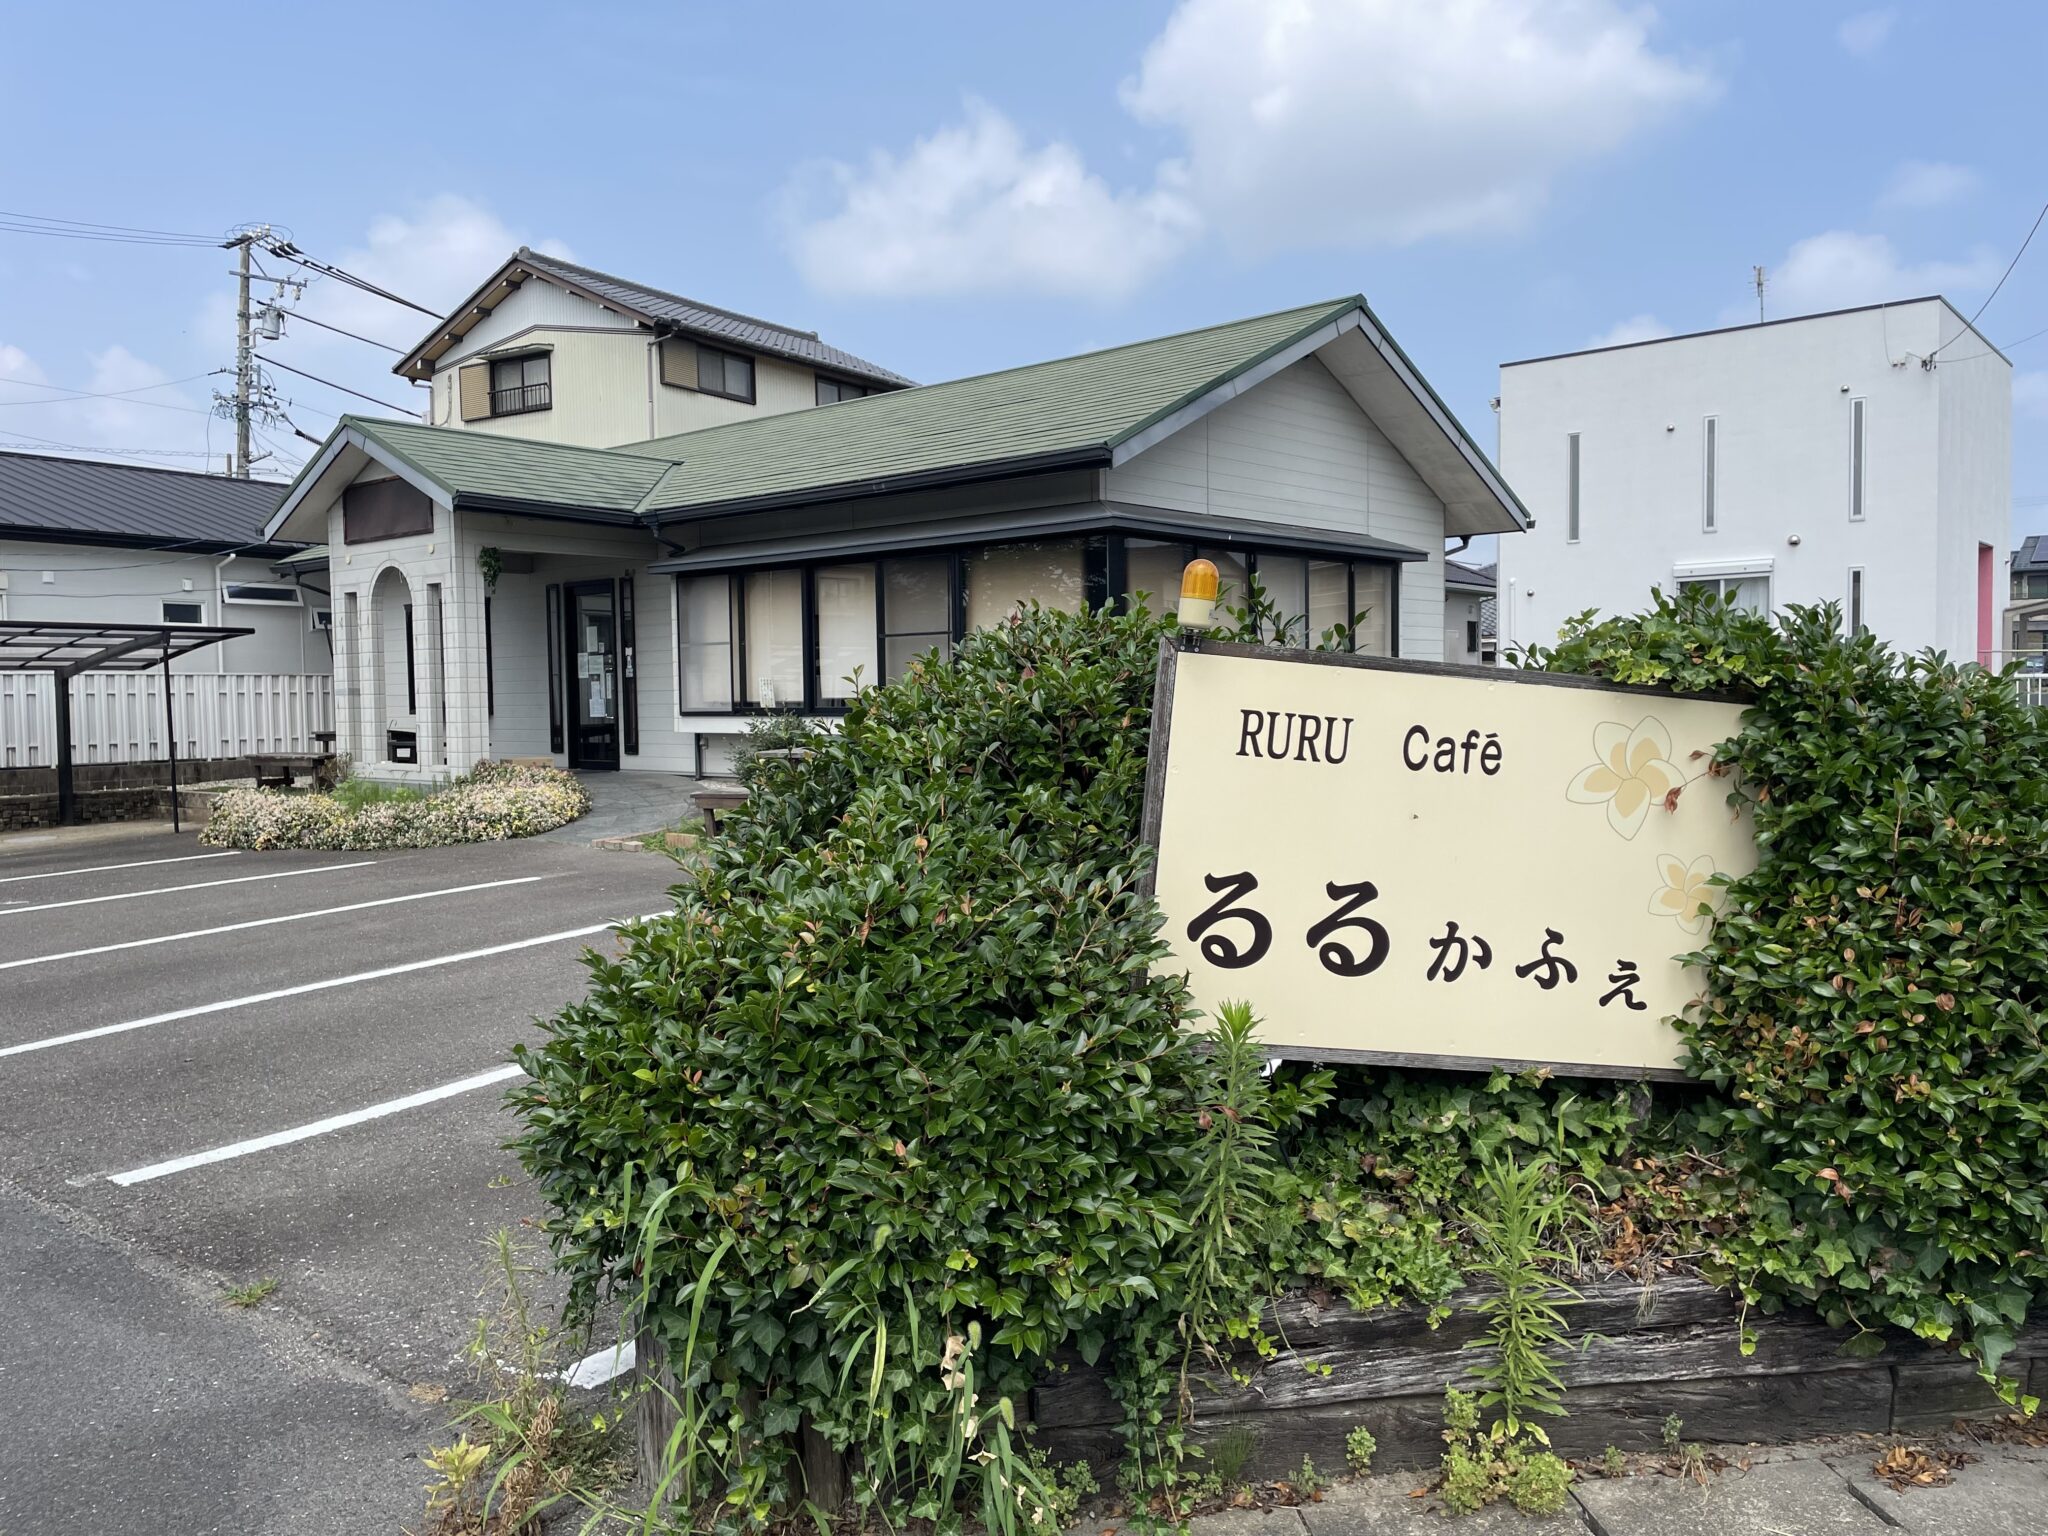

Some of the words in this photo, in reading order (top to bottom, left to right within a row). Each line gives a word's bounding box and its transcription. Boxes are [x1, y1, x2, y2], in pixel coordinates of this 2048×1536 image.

[1235, 709, 1354, 765] RURU
[1403, 724, 1503, 776] Café
[1186, 871, 1648, 1011] るるかふぇ
